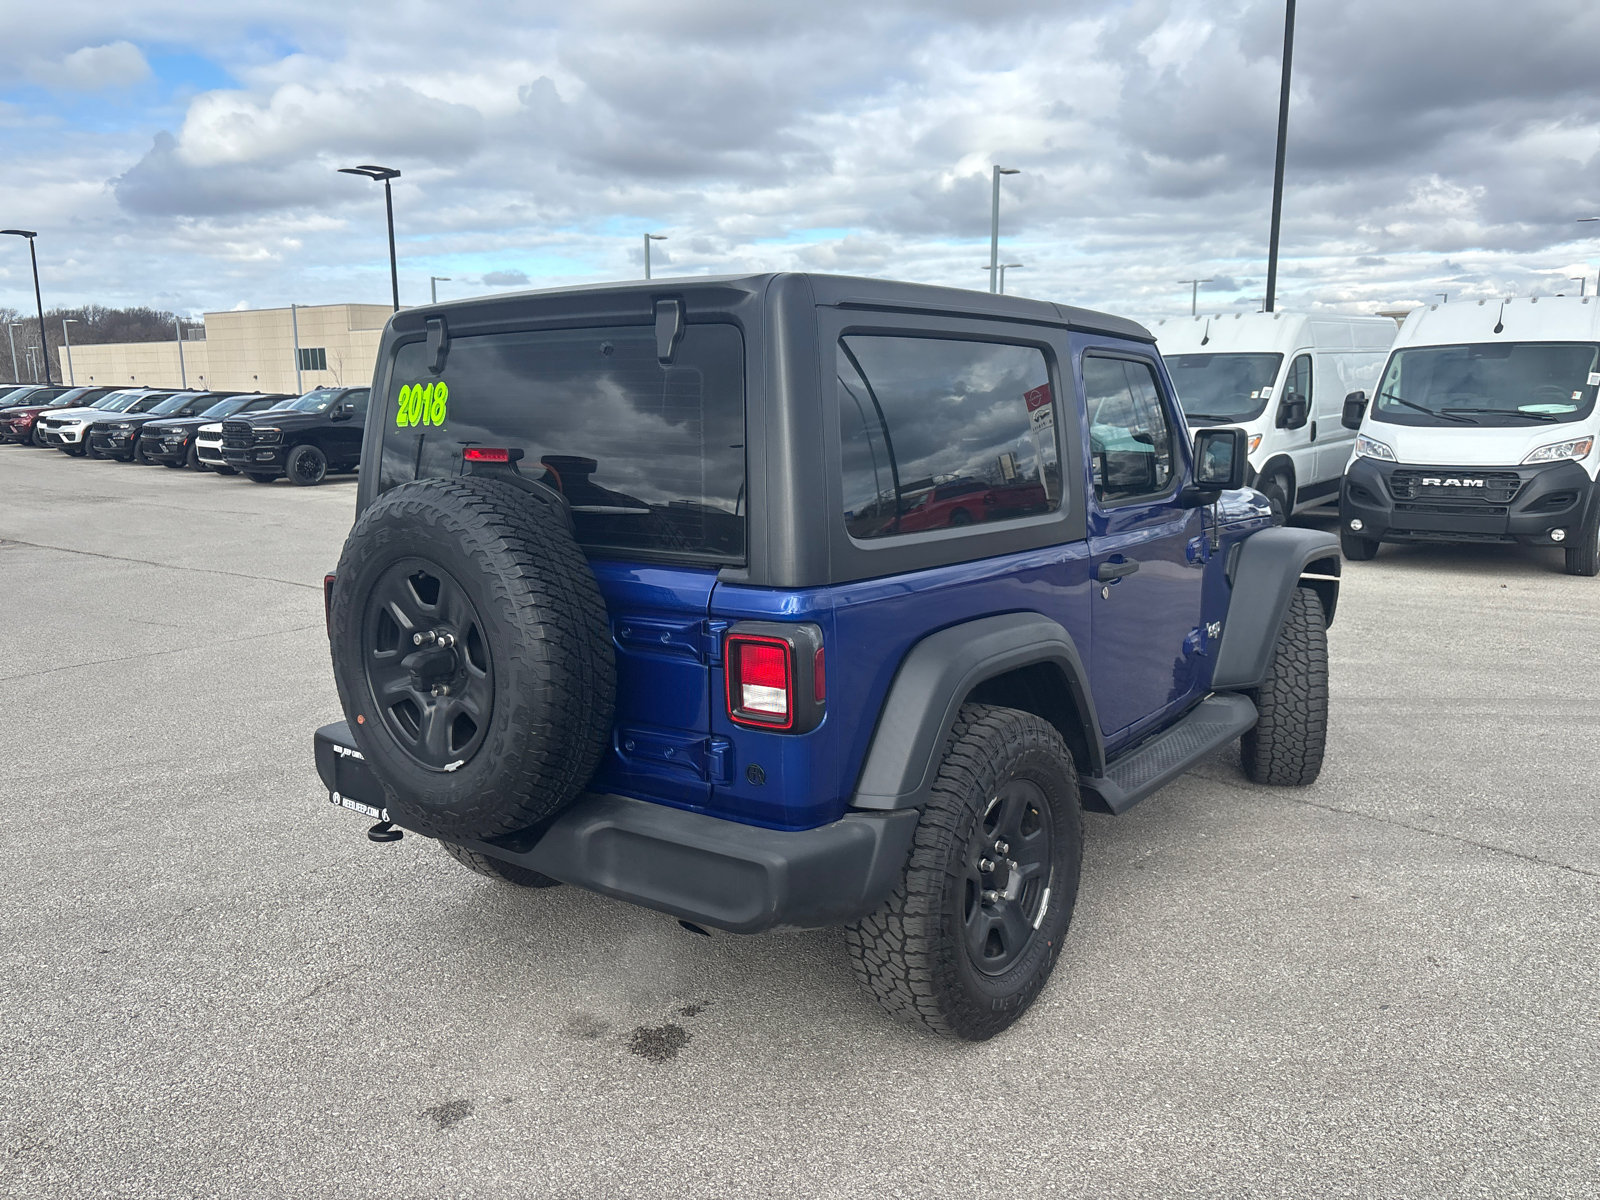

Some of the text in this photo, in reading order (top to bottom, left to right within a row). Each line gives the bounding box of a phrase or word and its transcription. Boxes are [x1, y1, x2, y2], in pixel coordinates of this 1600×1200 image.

[396, 381, 449, 427] 2018
[1422, 478, 1484, 487] RAM
[342, 797, 379, 818] REEDJEEP.COM
